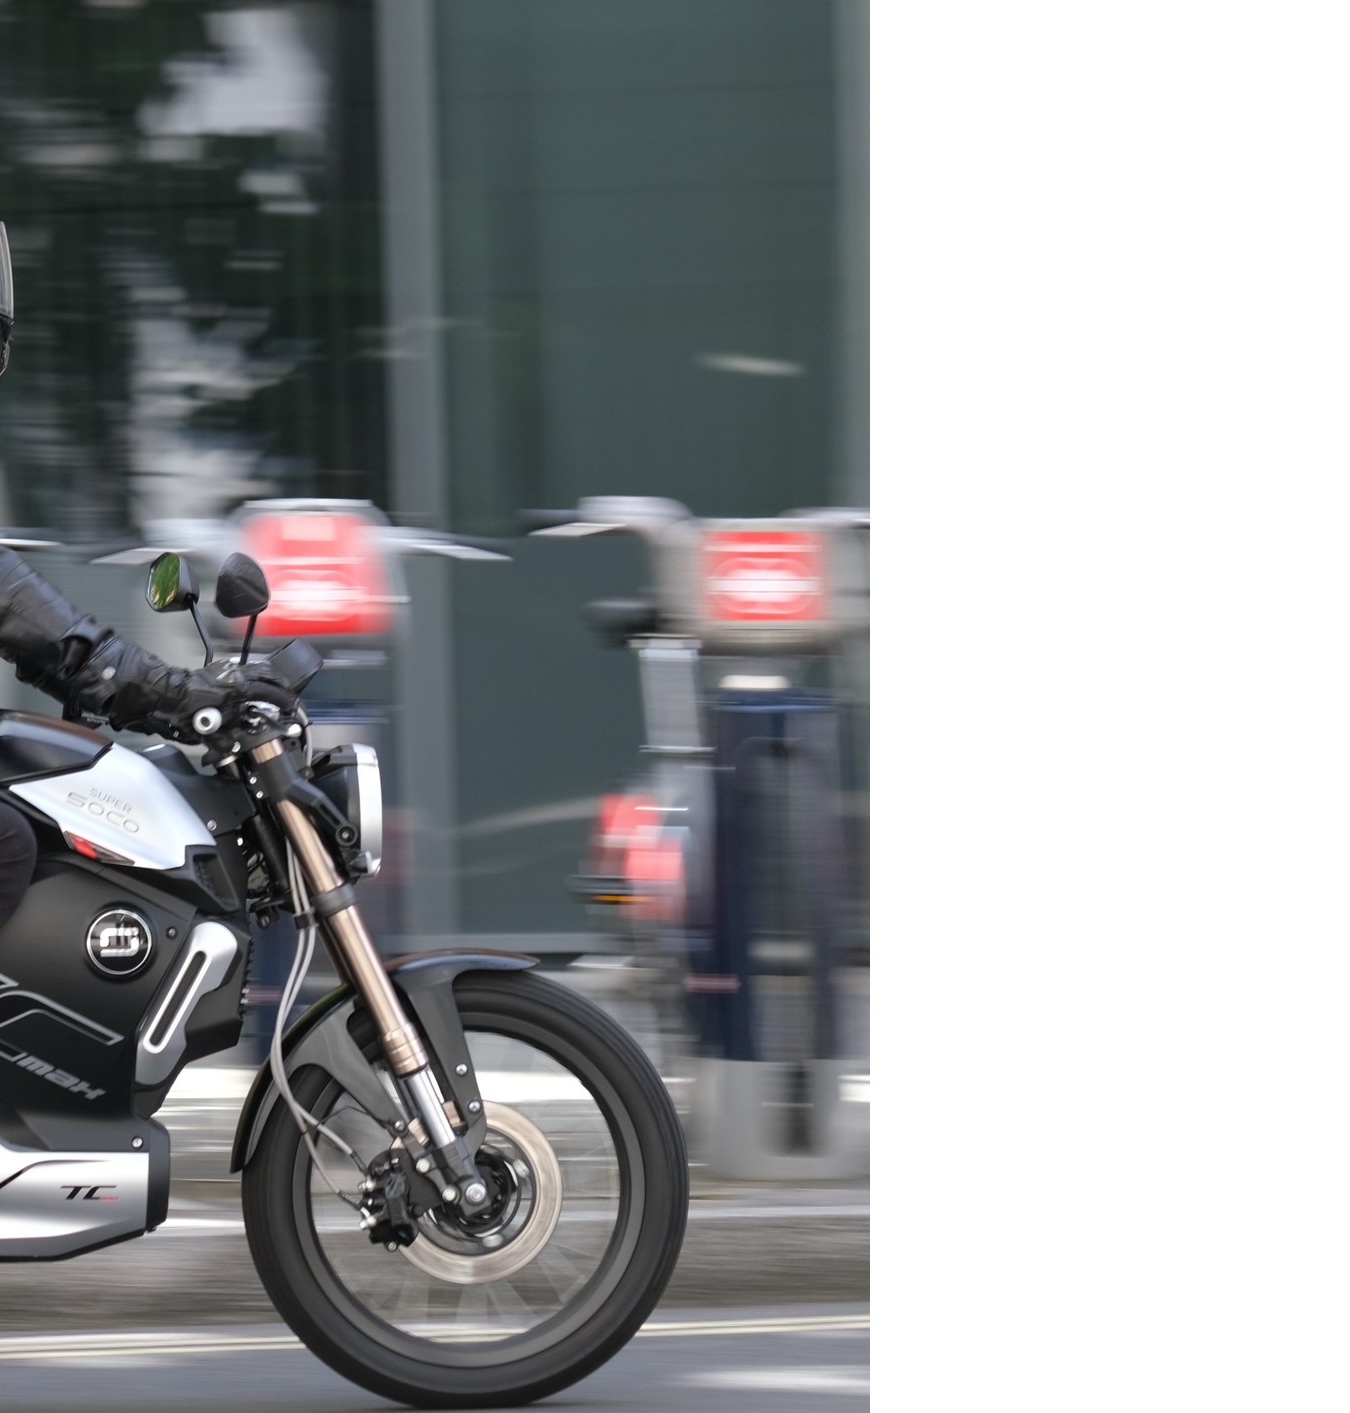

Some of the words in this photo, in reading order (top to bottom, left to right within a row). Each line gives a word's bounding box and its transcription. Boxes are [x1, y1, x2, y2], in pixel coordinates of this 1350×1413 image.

[66, 792, 140, 833] SOCO
[90, 788, 132, 814] SUPER
[61, 1185, 118, 1201] TC
